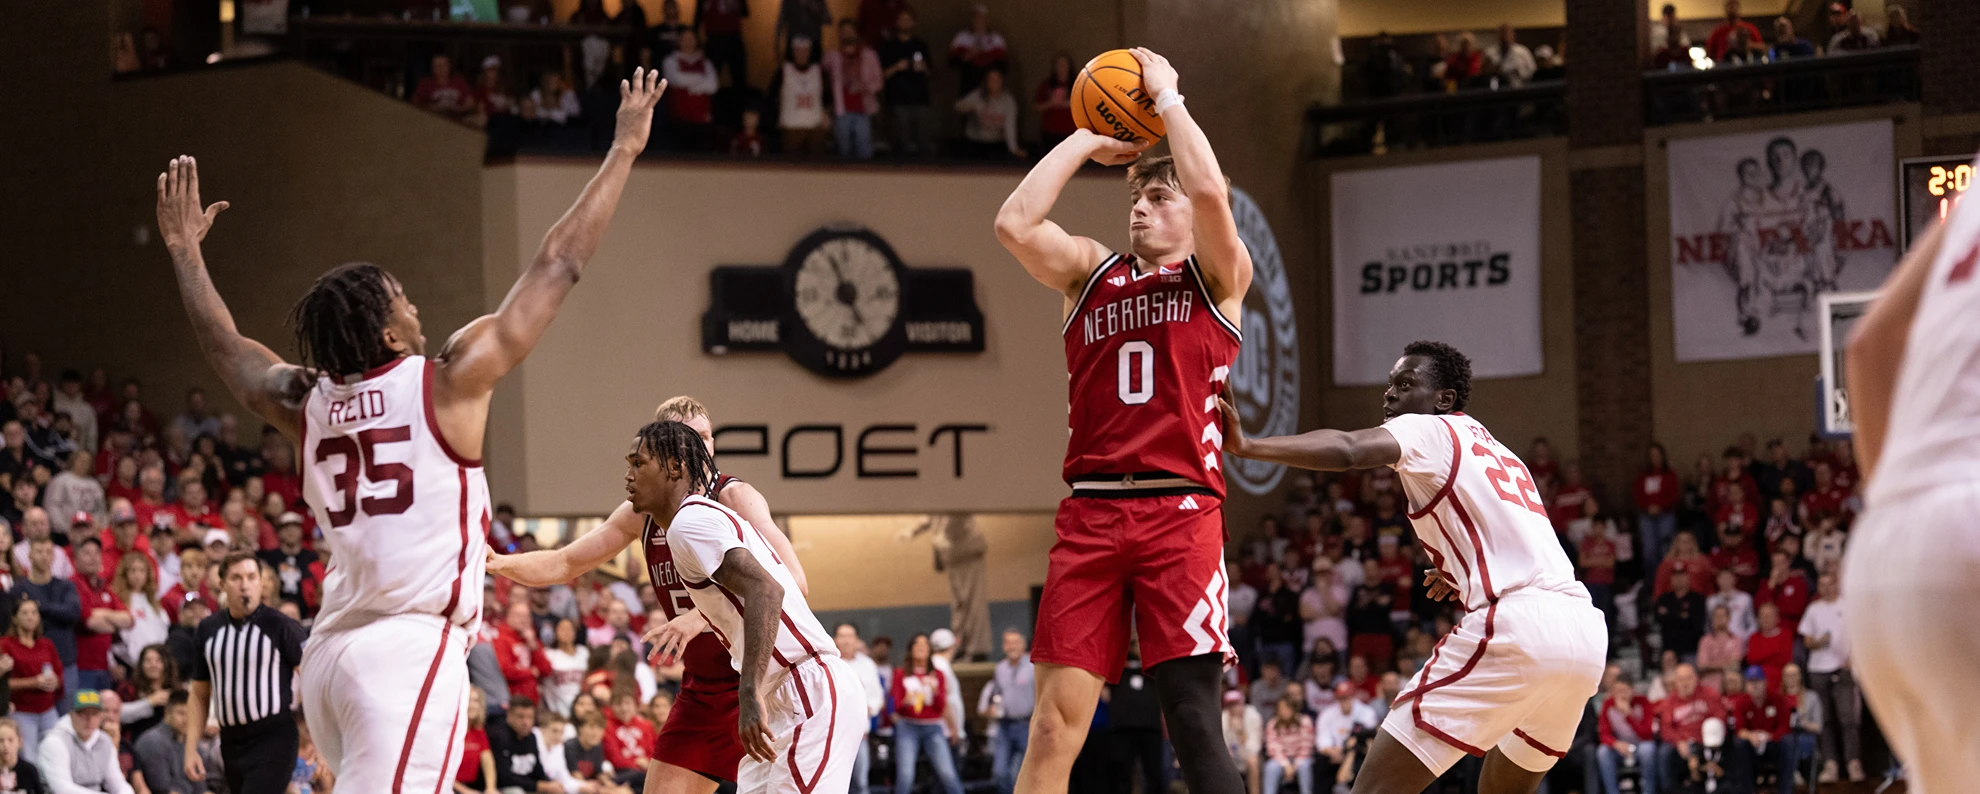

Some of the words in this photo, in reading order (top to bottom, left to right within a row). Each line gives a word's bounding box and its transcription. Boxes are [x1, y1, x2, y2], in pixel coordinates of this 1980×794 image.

[1095, 100, 1149, 141] ilson
[1928, 164, 1977, 197] 2:0
[1360, 252, 1511, 294] SPORTS
[728, 319, 780, 343] HOME
[905, 320, 973, 343] VISITOR
[1084, 290, 1193, 346] NEBRASKA
[1118, 340, 1154, 405] 0
[329, 390, 385, 426] REID
[711, 423, 988, 478] POET
[315, 424, 414, 529] 35
[1471, 442, 1549, 519] 22
